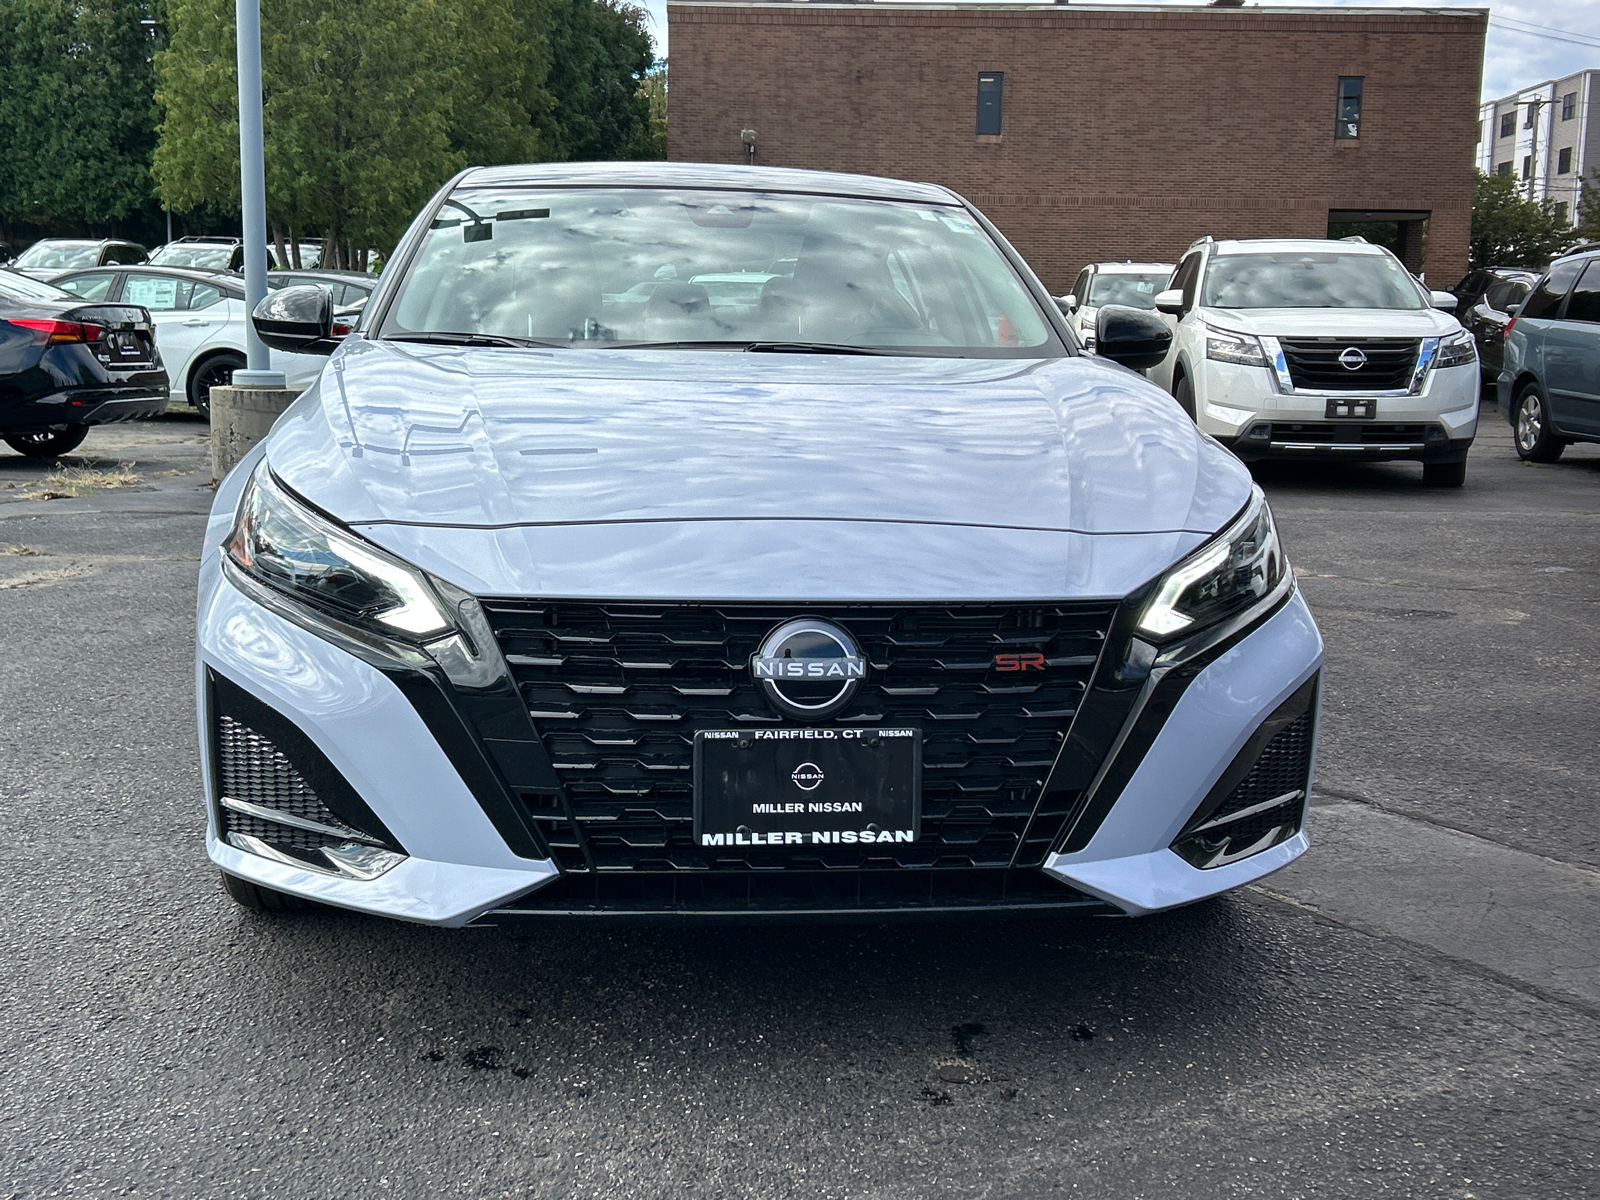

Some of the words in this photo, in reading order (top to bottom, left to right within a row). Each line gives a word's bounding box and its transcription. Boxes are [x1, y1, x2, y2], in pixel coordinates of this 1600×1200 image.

[995, 653, 1046, 671] SR
[756, 661, 864, 677] NISSAN
[704, 731, 739, 739] NISSAN
[754, 730, 838, 740] FAIRFIELD,
[843, 730, 864, 738] CT
[752, 803, 804, 813] MILLER
[809, 802, 862, 812] NISSAN
[702, 832, 803, 846] MILLER
[812, 830, 914, 844] NISSAN
